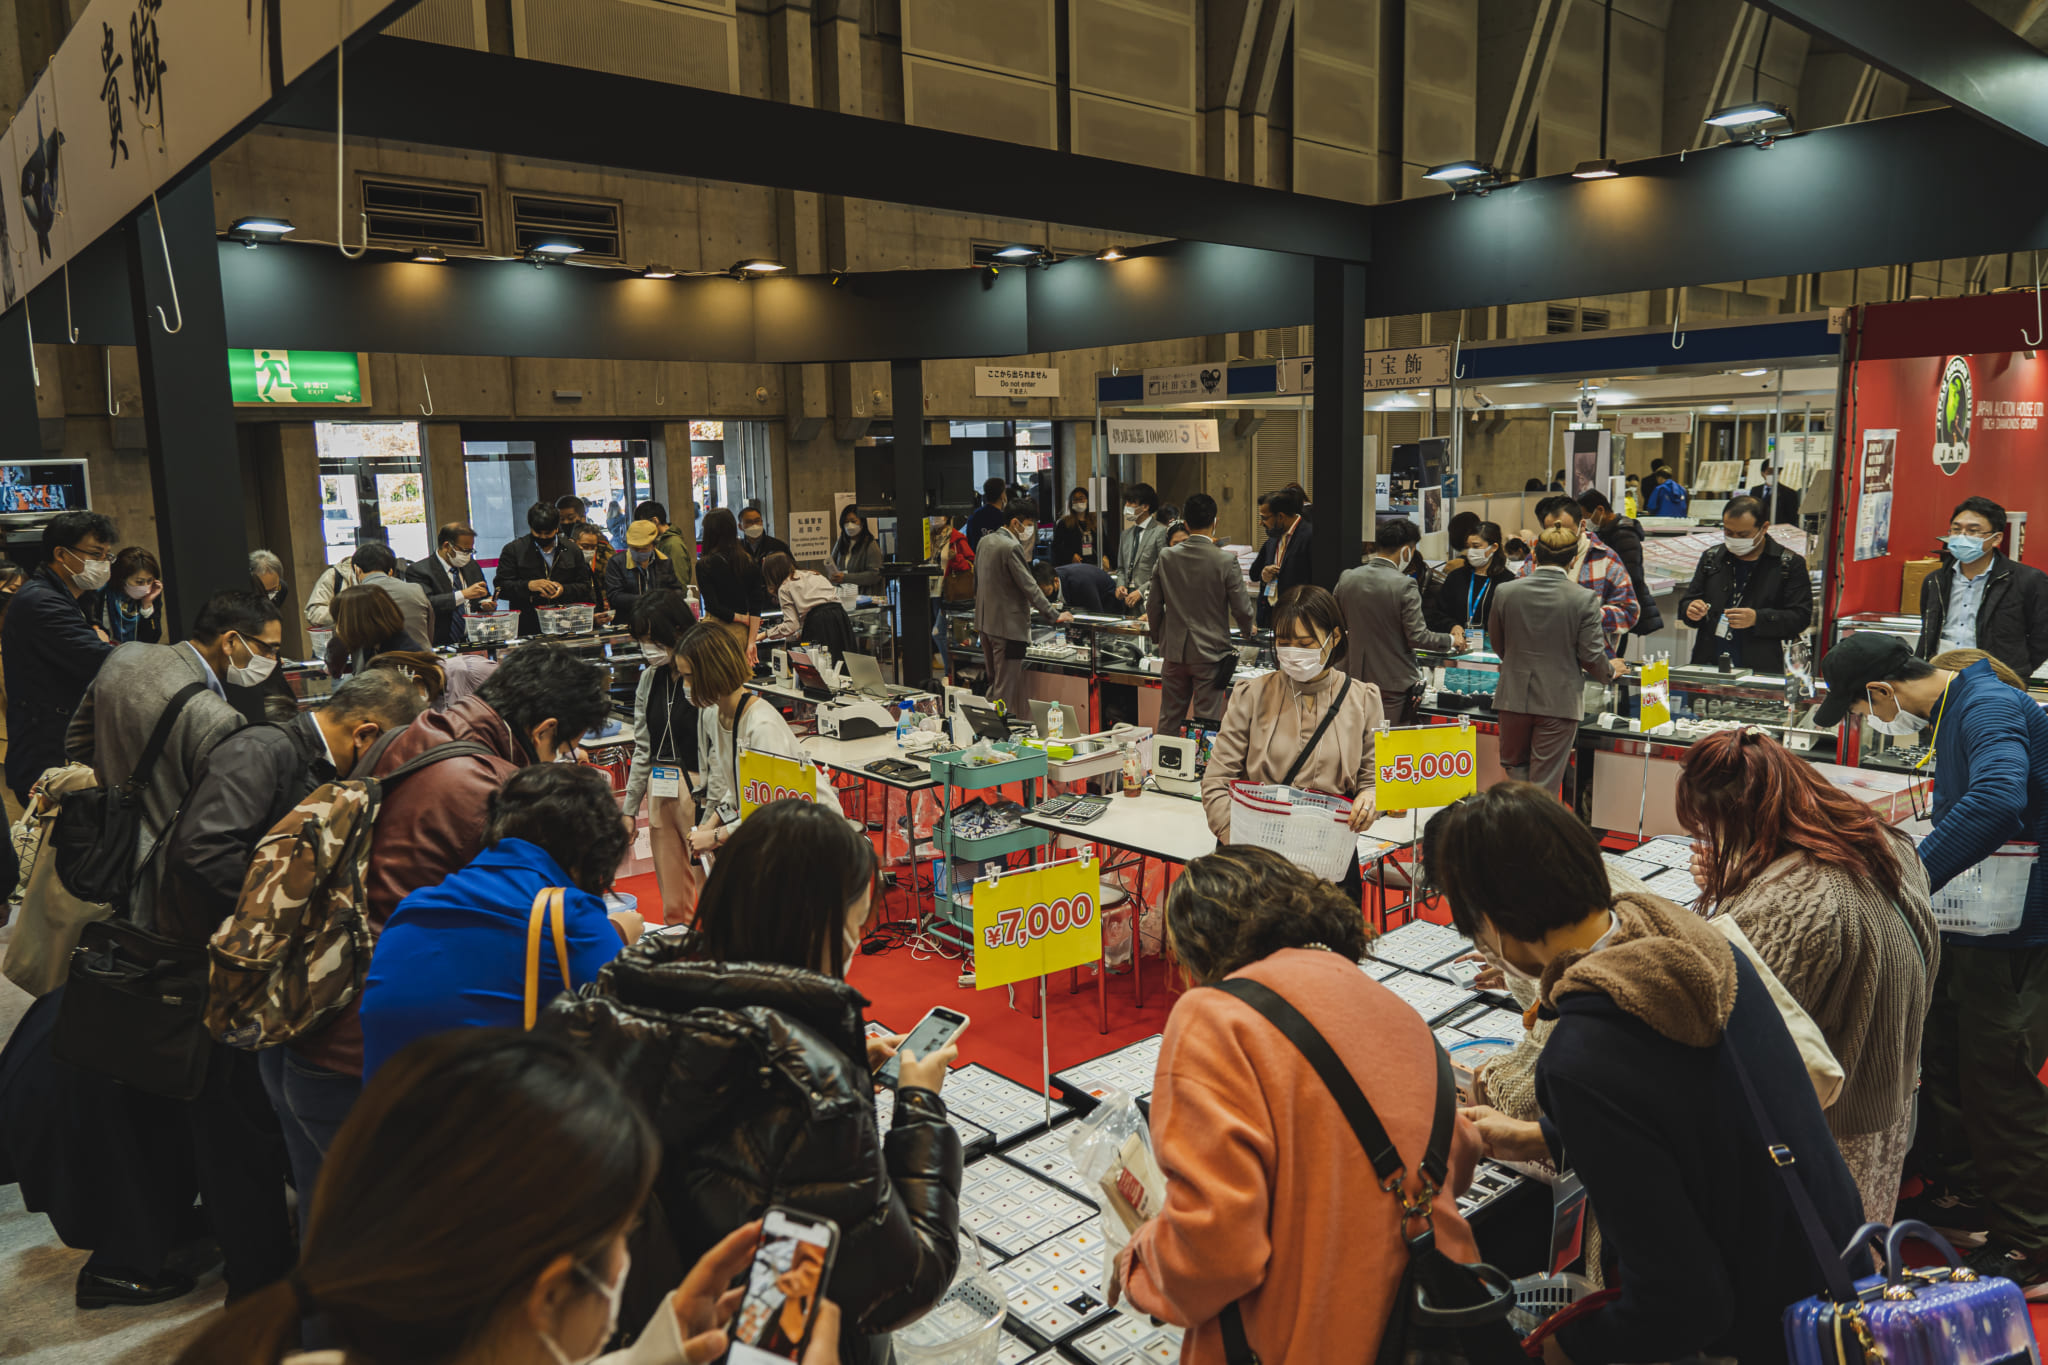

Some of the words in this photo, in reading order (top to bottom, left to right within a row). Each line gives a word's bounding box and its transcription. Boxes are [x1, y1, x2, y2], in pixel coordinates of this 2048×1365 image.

[987, 370, 1048, 379] ここから出られません
[1000, 380, 1009, 388] Do
[1010, 380, 1020, 388] not
[1375, 376, 1423, 388] JEWELRY
[1940, 449, 1964, 461] JAH
[1380, 750, 1473, 785] ¥5,000
[984, 891, 1094, 949] ¥7,000
